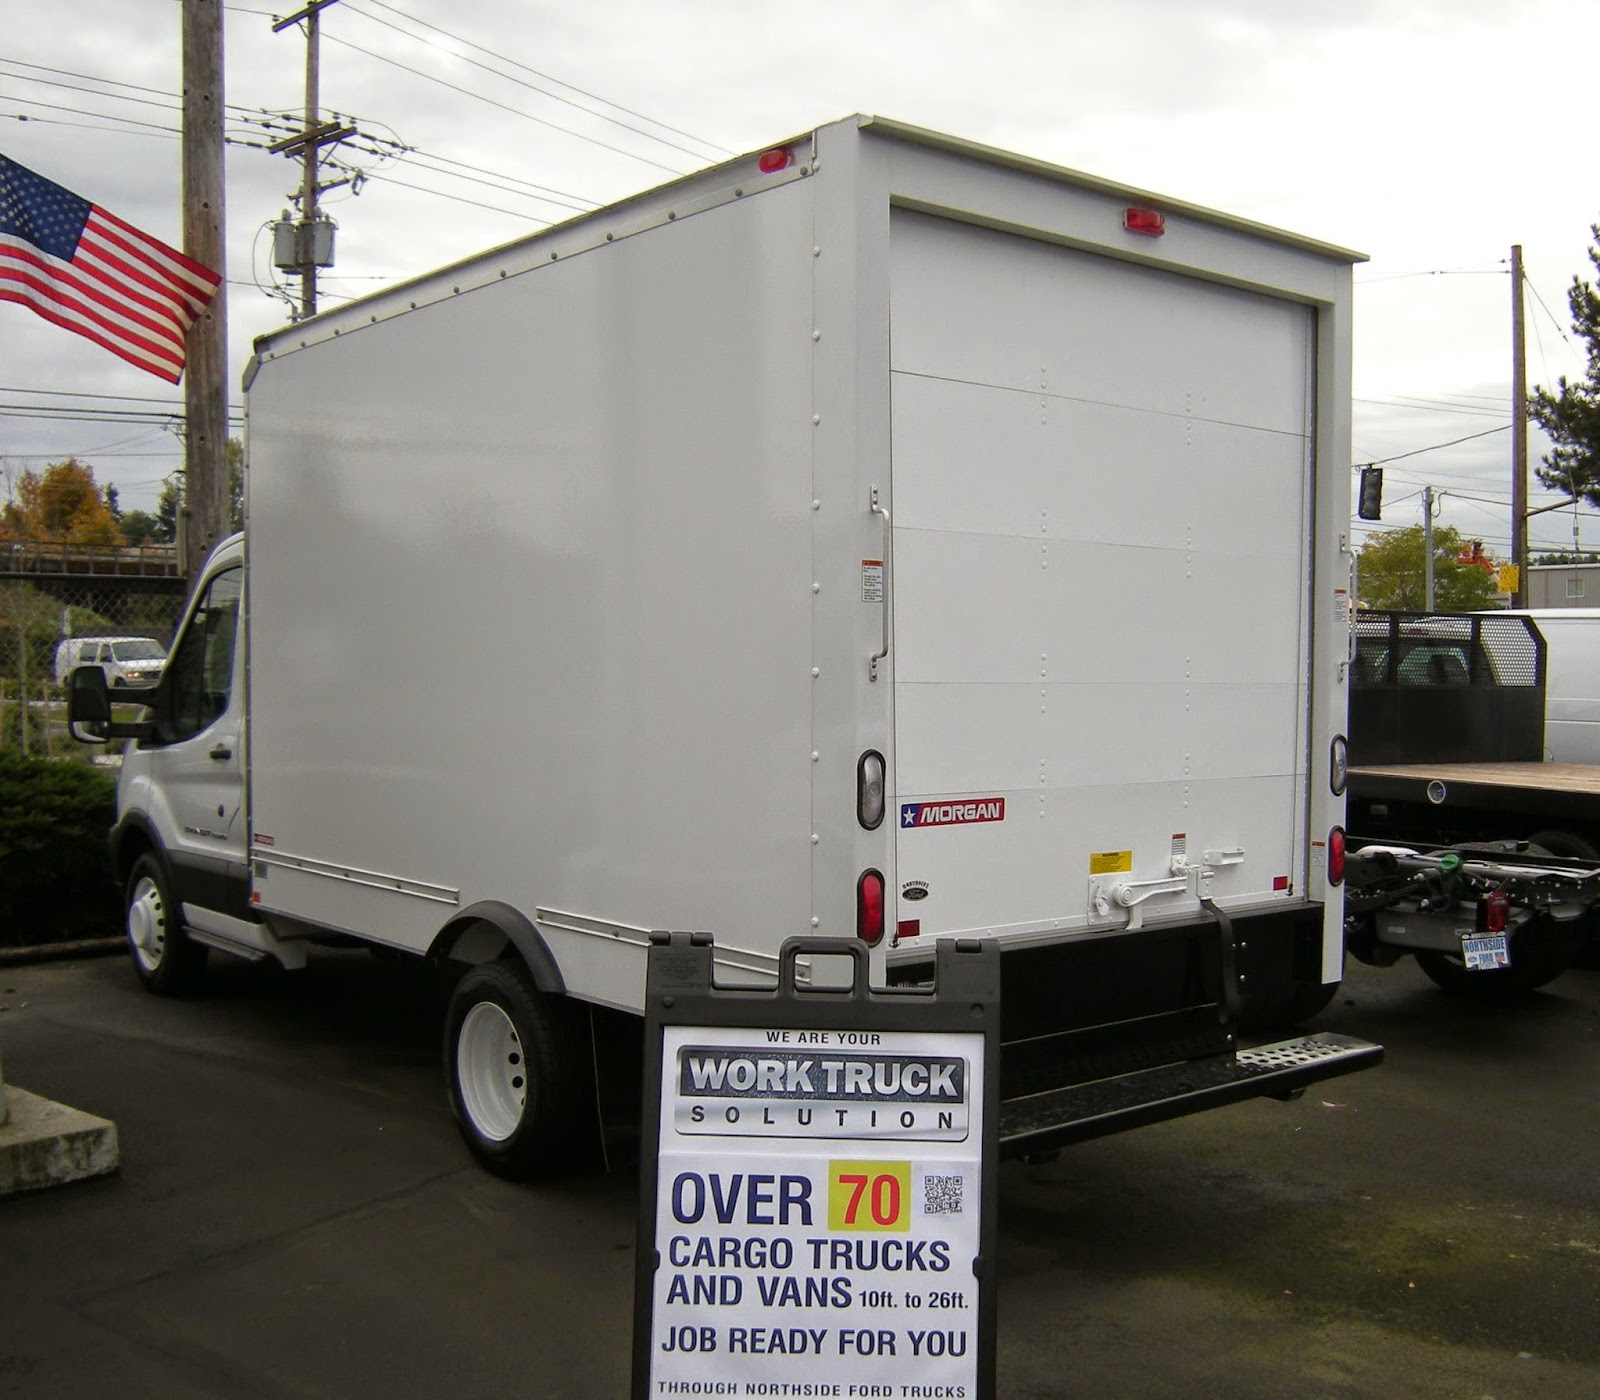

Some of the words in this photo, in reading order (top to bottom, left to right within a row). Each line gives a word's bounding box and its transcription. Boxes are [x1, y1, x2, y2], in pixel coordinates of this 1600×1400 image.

[920, 802, 1000, 823] MORGAN
[1464, 939, 1504, 952] NORTHSIDE
[766, 1031, 790, 1043] WE
[798, 1032, 830, 1044] ARE
[837, 1033, 881, 1045] YOUR
[689, 1057, 816, 1093] WORK
[821, 1061, 958, 1097] TRUCK
[691, 1105, 953, 1129] SOLUTION
[671, 1172, 813, 1225] OVER
[838, 1174, 901, 1226] 70
[669, 1237, 794, 1269] CARGO
[807, 1239, 950, 1272] TRUCKS
[666, 1274, 743, 1306] AND
[756, 1276, 852, 1308] VANS
[859, 1290, 898, 1308] 10ft.
[905, 1292, 922, 1308] to
[928, 1291, 969, 1309] 26ft.
[662, 1325, 717, 1353] JOB
[729, 1327, 828, 1355] READY
[838, 1329, 896, 1356] FOR
[908, 1330, 967, 1357] YOU
[658, 1381, 737, 1395] THROUGH
[745, 1383, 840, 1397] NORTHSIDE
[849, 1384, 892, 1398] FORD
[901, 1385, 966, 1398] TRUCKS
